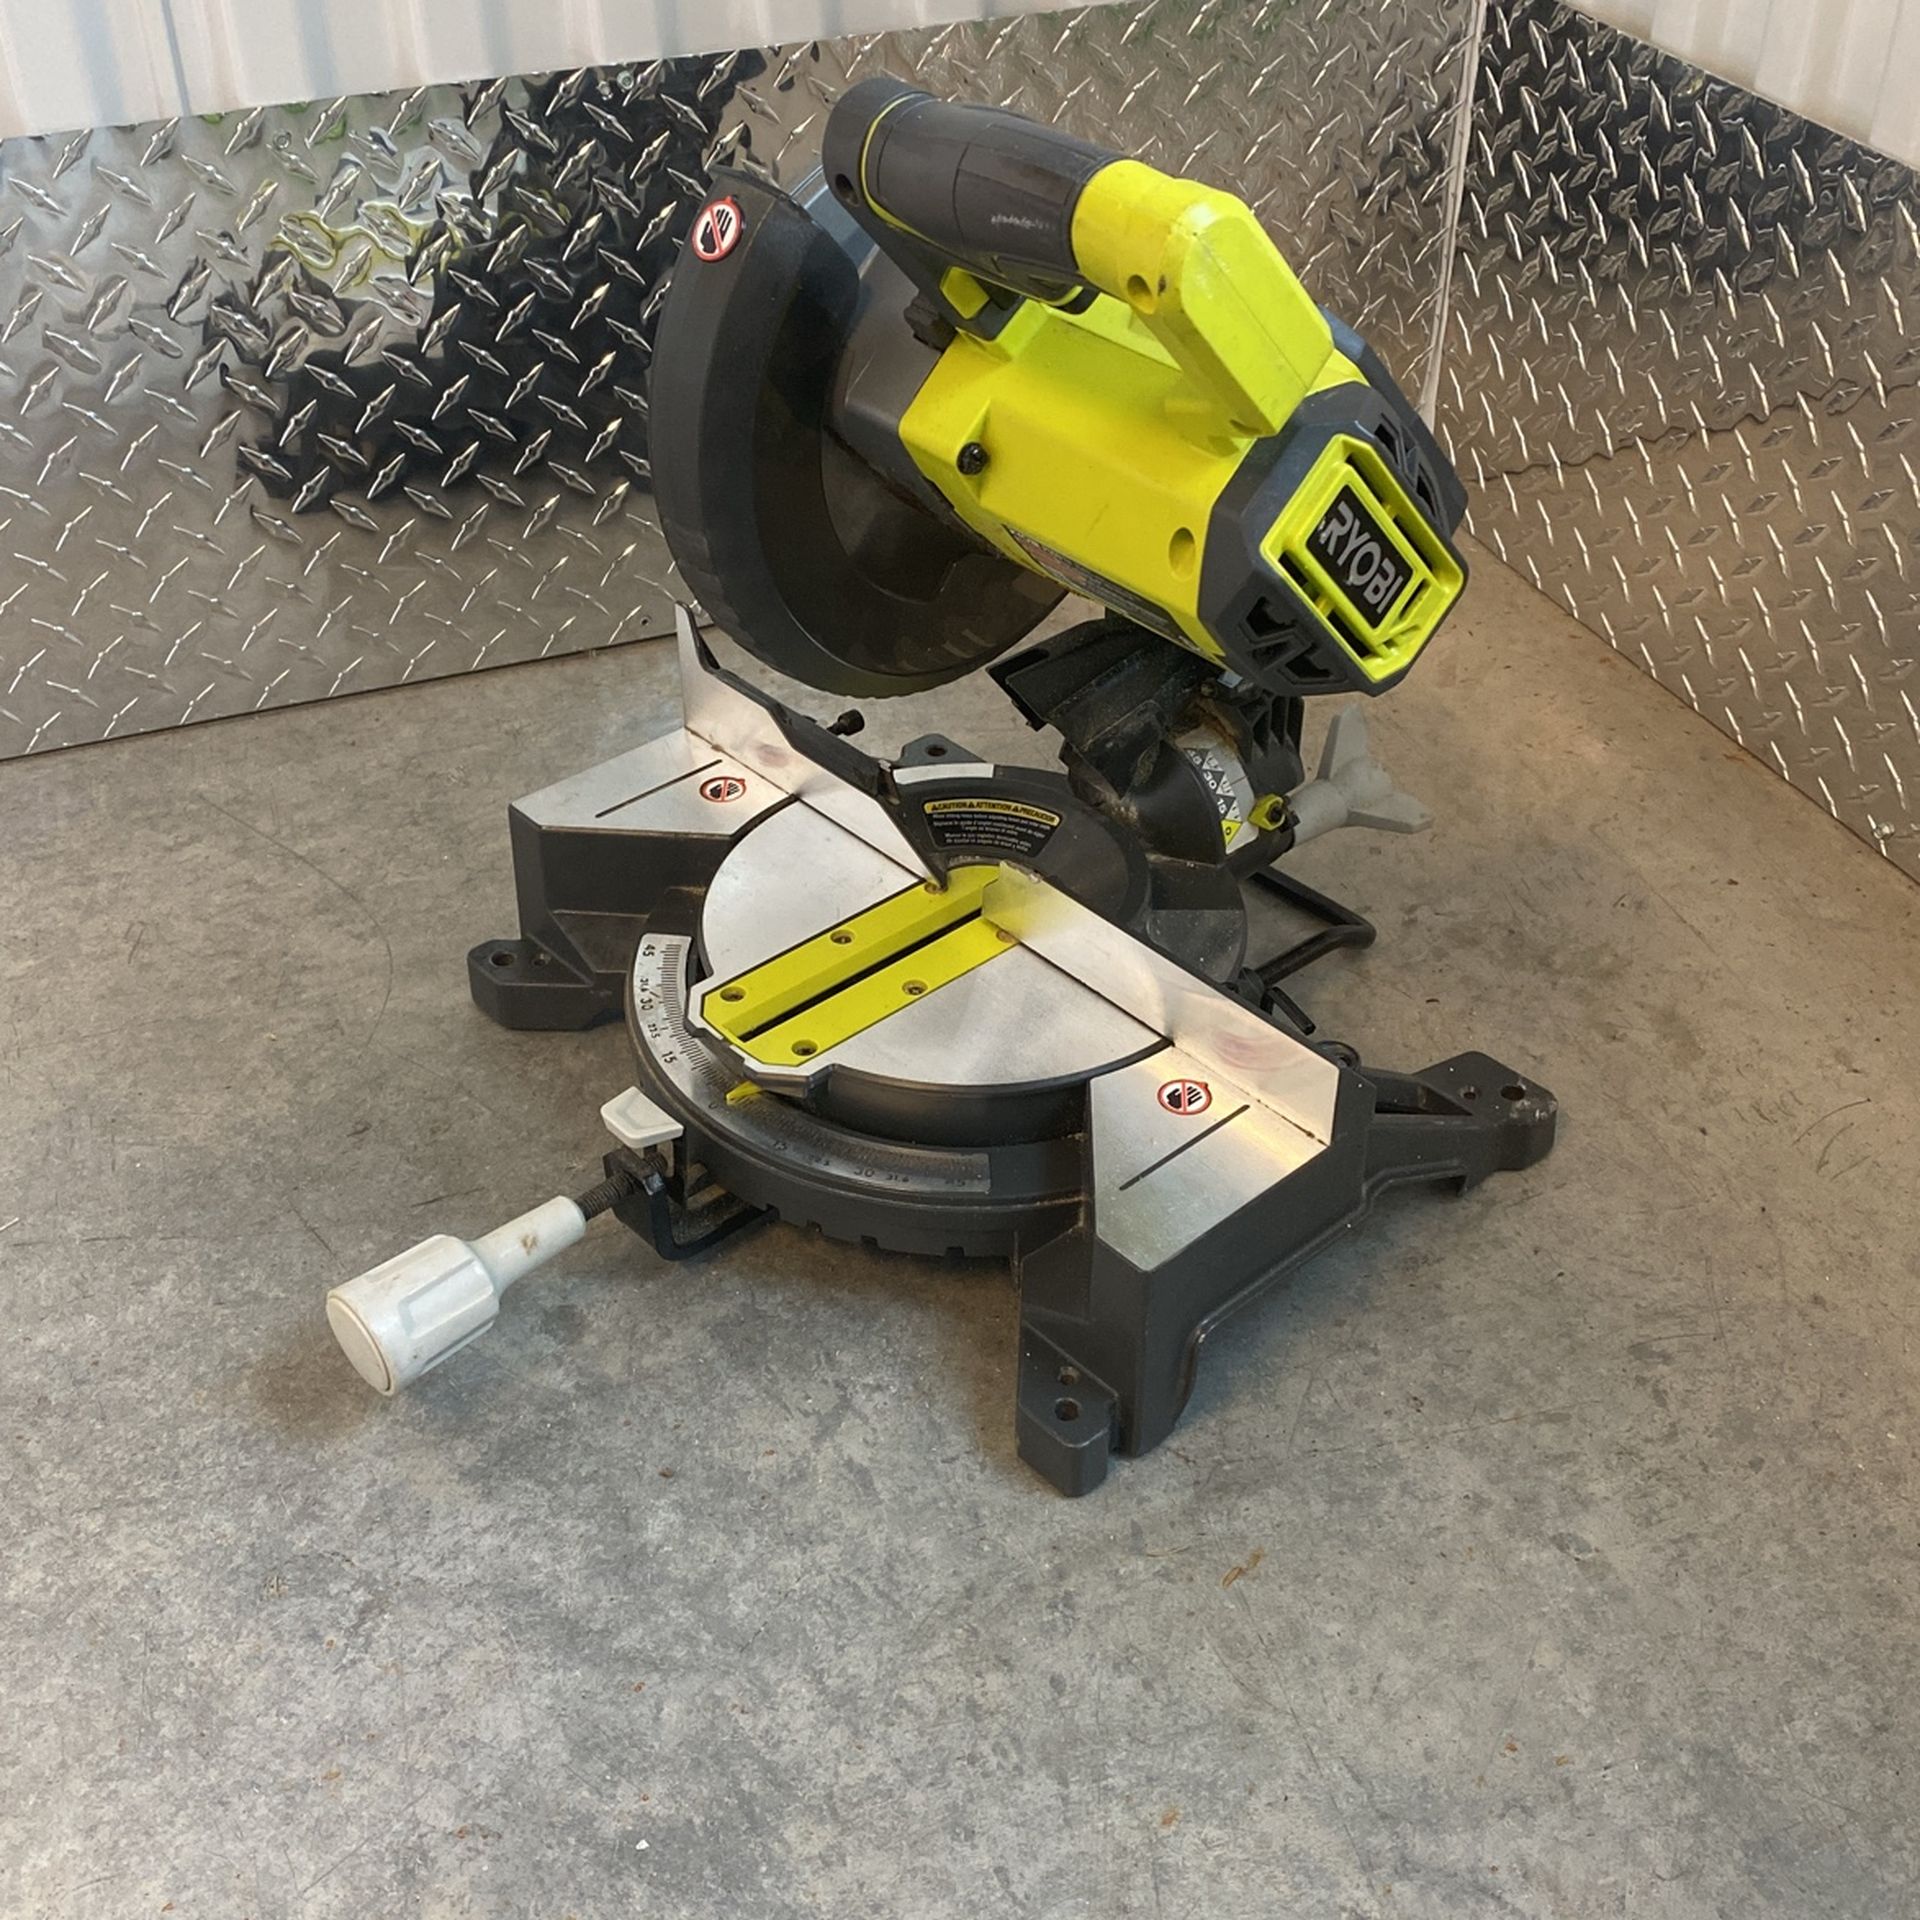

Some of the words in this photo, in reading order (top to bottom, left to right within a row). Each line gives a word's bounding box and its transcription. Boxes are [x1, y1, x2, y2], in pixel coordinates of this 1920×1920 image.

[1320, 501, 1403, 614] RYOBI
[1203, 771, 1217, 790] 30
[936, 801, 967, 811] CAUTION
[976, 801, 1011, 812] ATTENTION
[1225, 826, 1232, 836] 0
[643, 944, 656, 957] 45
[640, 998, 654, 1011] 30
[661, 1050, 678, 1065] 15
[854, 1167, 875, 1178] 30
